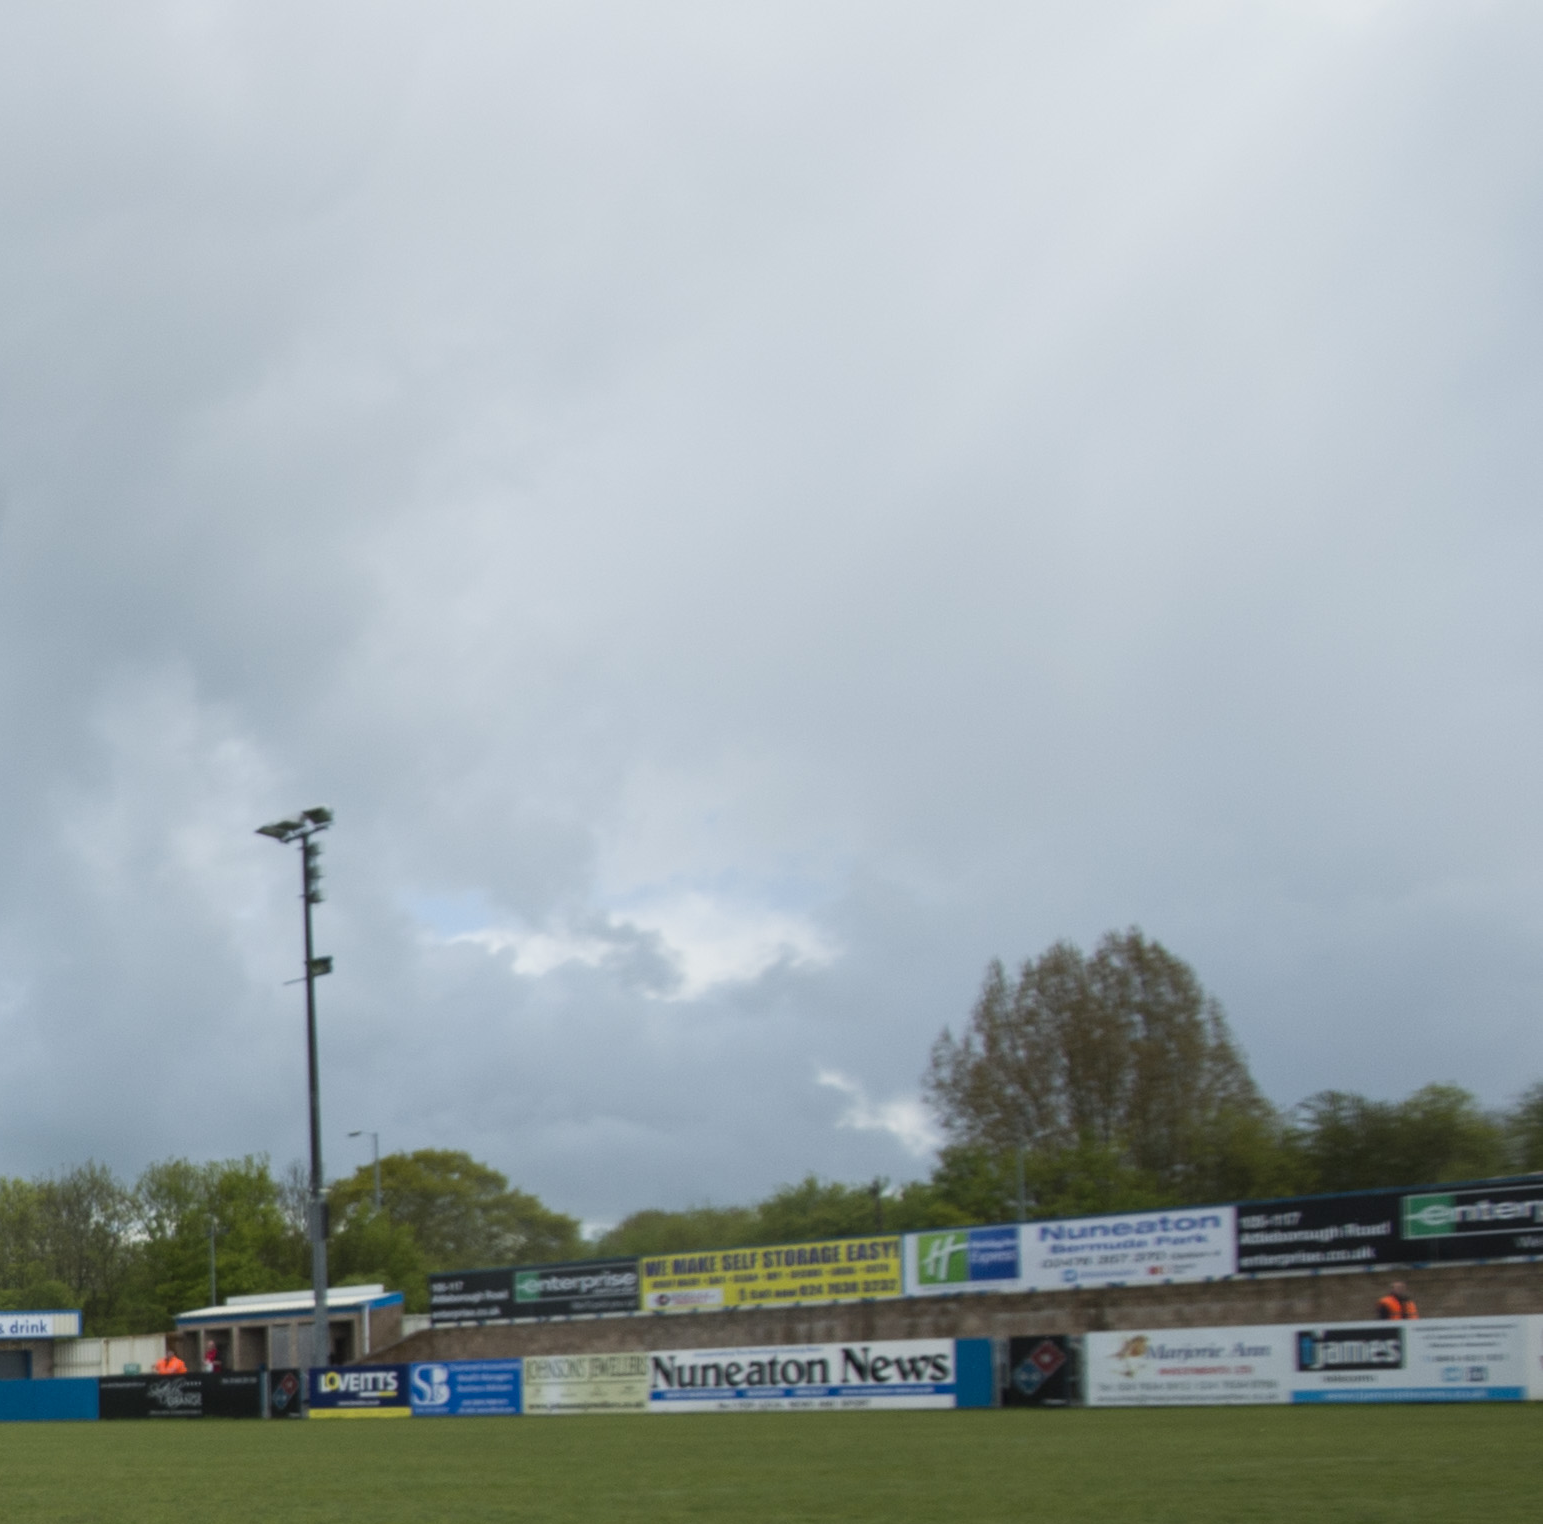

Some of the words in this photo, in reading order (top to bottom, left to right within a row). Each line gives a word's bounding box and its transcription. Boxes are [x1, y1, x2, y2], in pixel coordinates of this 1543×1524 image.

[1039, 1214, 1221, 1241] Nuneaton
[1154, 1233, 1208, 1248] Park
[722, 1252, 757, 1271] SELF
[762, 1246, 842, 1269] STORAGE
[523, 1271, 638, 1293] enterprise
[10, 1319, 48, 1335] drink
[650, 1354, 832, 1388] Nuneaton
[841, 1347, 951, 1383] News
[320, 1371, 398, 1393] LOVEITTS
